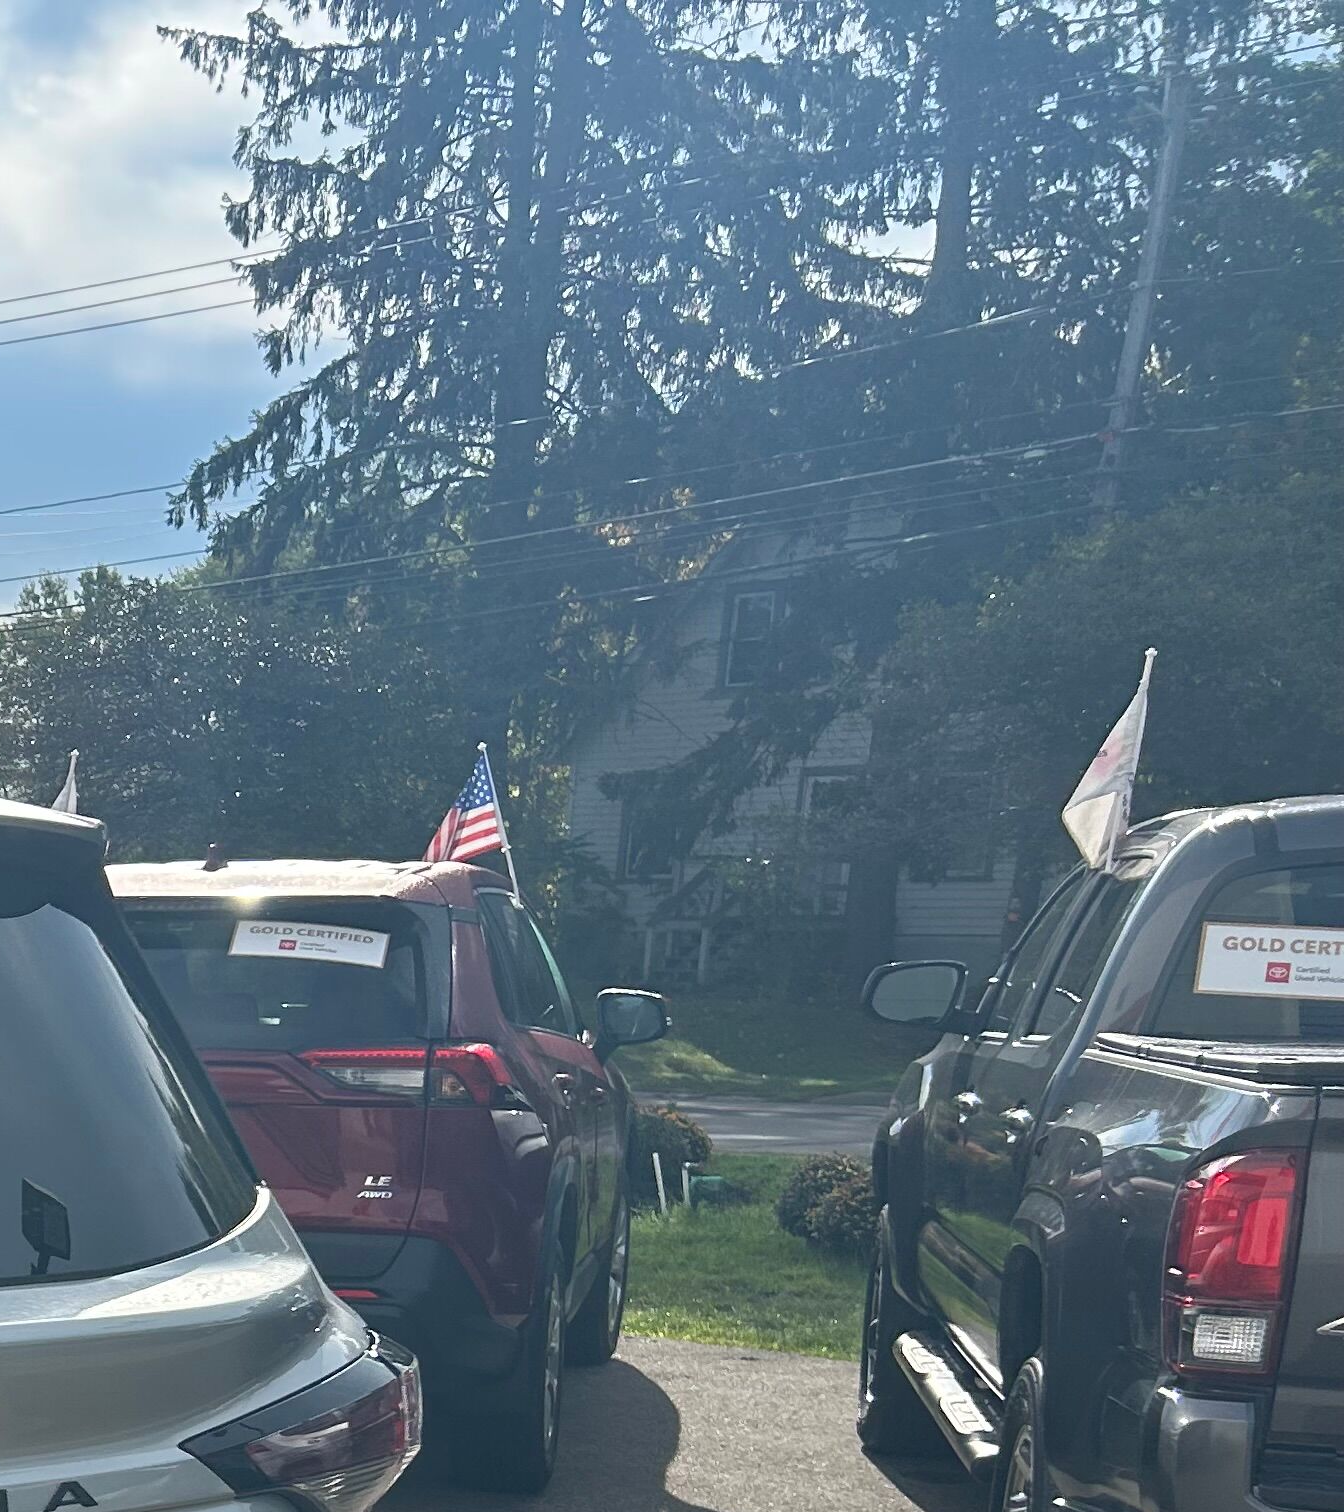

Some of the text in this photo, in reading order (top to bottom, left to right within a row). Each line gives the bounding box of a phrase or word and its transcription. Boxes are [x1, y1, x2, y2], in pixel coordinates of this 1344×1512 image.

[249, 925, 374, 945] GOLD CERTIFIED
[1222, 935, 1286, 953] GOLD
[364, 1175, 393, 1187] LE
[356, 1190, 393, 1199] AWD
